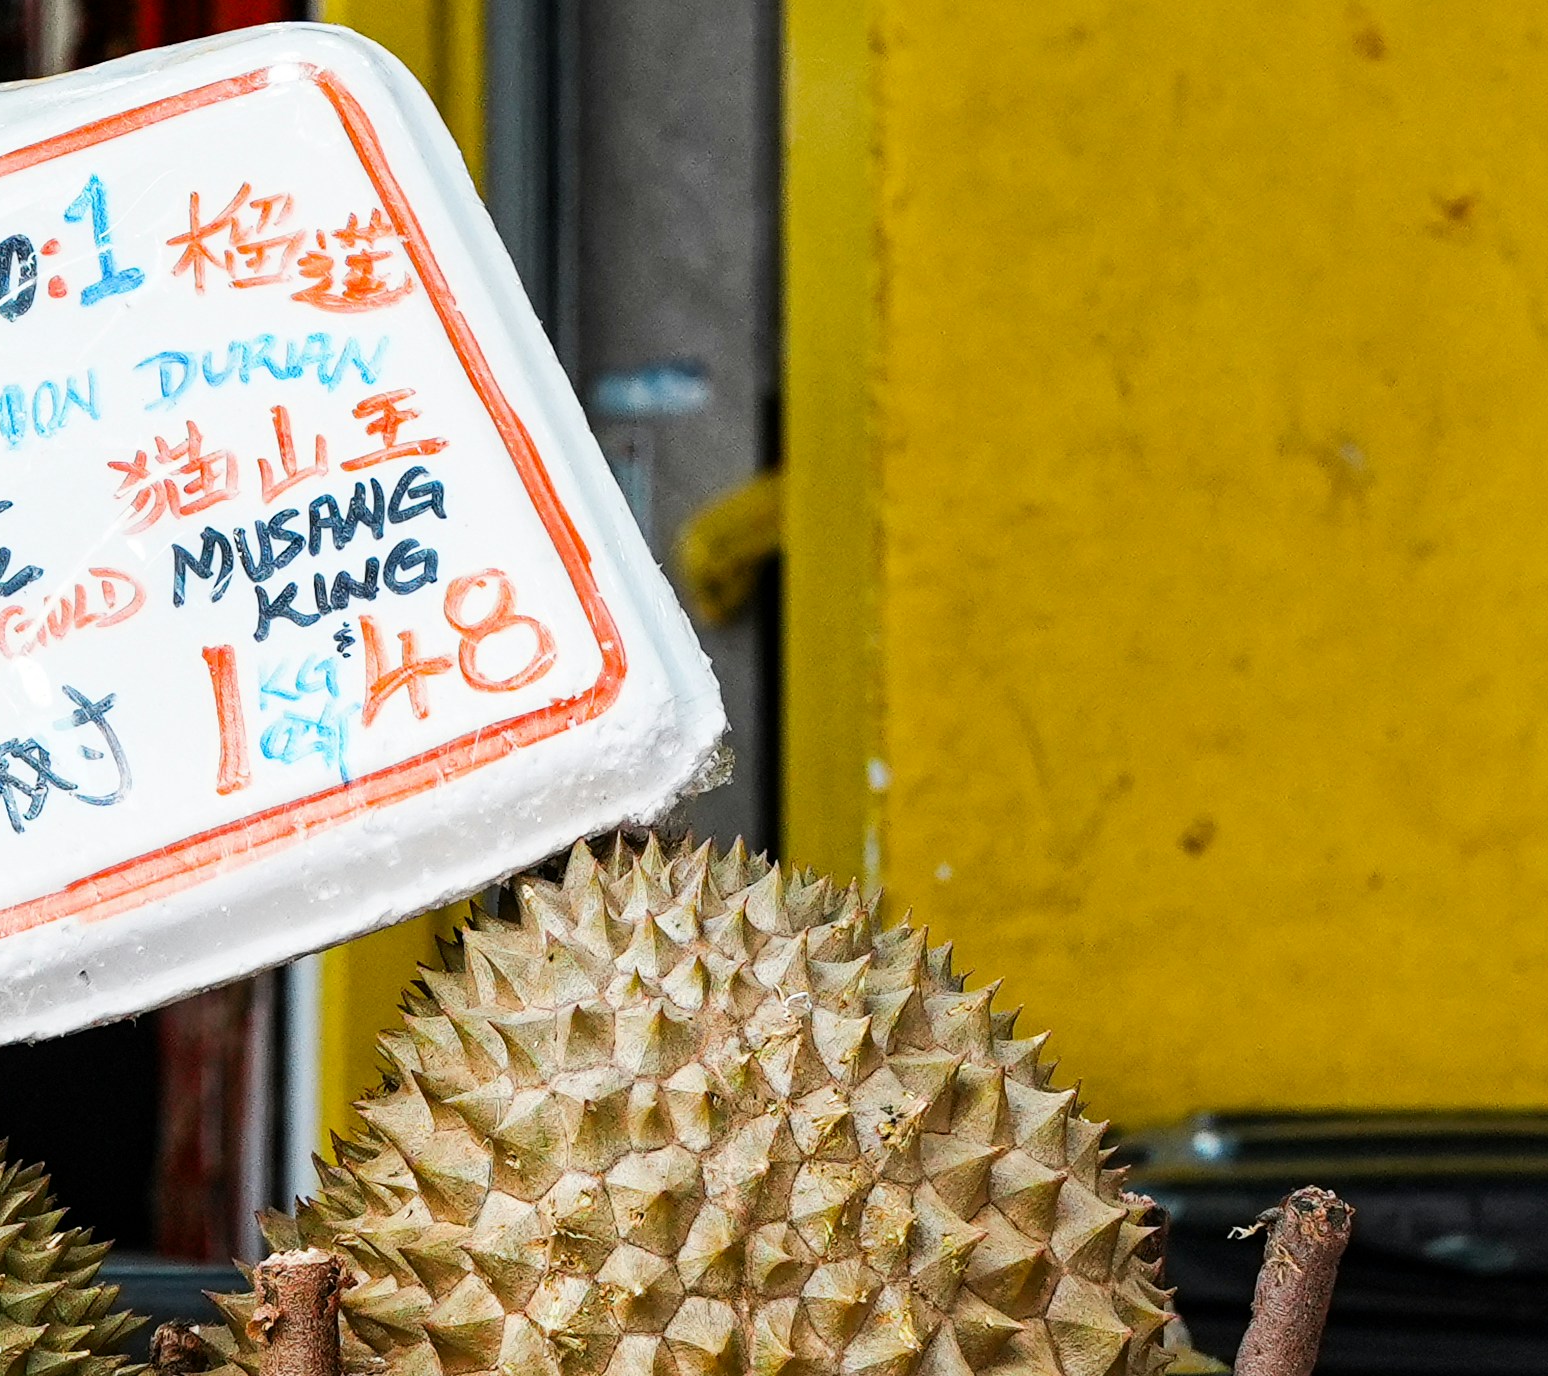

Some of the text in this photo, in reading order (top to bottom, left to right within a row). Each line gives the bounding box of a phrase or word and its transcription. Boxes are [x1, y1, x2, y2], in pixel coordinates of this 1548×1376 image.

[133, 333, 390, 412] DURIAN
[107, 388, 451, 536] 猫山王
[171, 466, 447, 607] MUSANG
[253, 538, 438, 643] KING
